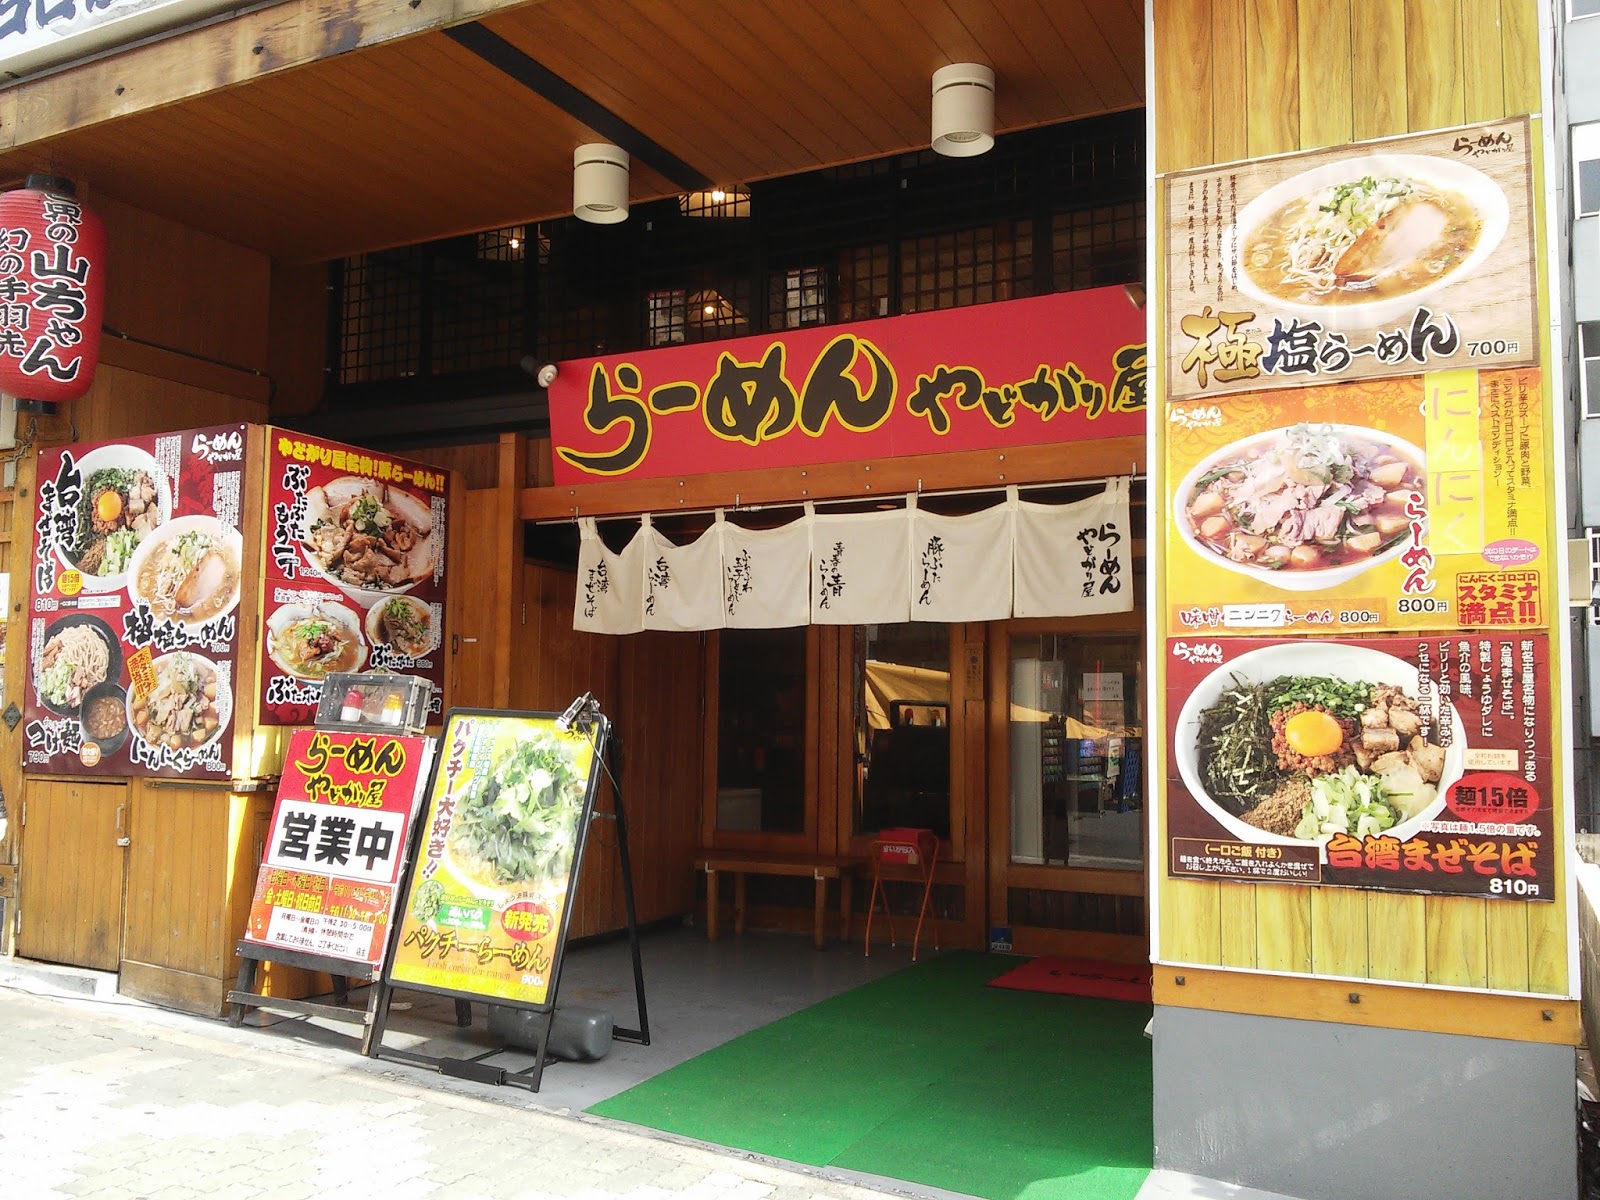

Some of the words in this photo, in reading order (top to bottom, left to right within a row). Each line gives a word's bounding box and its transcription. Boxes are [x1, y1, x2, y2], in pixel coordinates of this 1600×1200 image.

[20, 193, 90, 383] 界の山ちゃん
[1467, 340, 1519, 357] 700円
[556, 333, 898, 476] らーめん
[1077, 528, 1098, 598] やどがり屋
[1098, 522, 1121, 595] らーめん
[1459, 573, 1536, 583] にんにくゴロゴロ
[35, 598, 58, 612] 810円
[1397, 598, 1448, 613] 800円
[1459, 582, 1538, 601] スタミナ
[1459, 601, 1536, 624] 満点!!
[1340, 611, 1379, 623] 800円
[1458, 641, 1472, 698] 魚介の風味、
[1479, 640, 1493, 737] 特製しょうゆダレに
[1418, 642, 1431, 747] クセになる一杯です!
[1438, 641, 1452, 747] ピリリと効いた辛みが
[1521, 640, 1536, 782] 新名古屋名物になりつつある
[28, 750, 49, 763] 790円
[295, 732, 405, 777] らーめん
[1455, 786, 1528, 808] 麺1.5倍
[278, 810, 393, 871] 営業中
[1325, 832, 1539, 877] 台湾まぜそば
[1489, 878, 1540, 896] 810円
[504, 909, 550, 933] 新発売
[404, 926, 550, 973] パクチーらーめん
